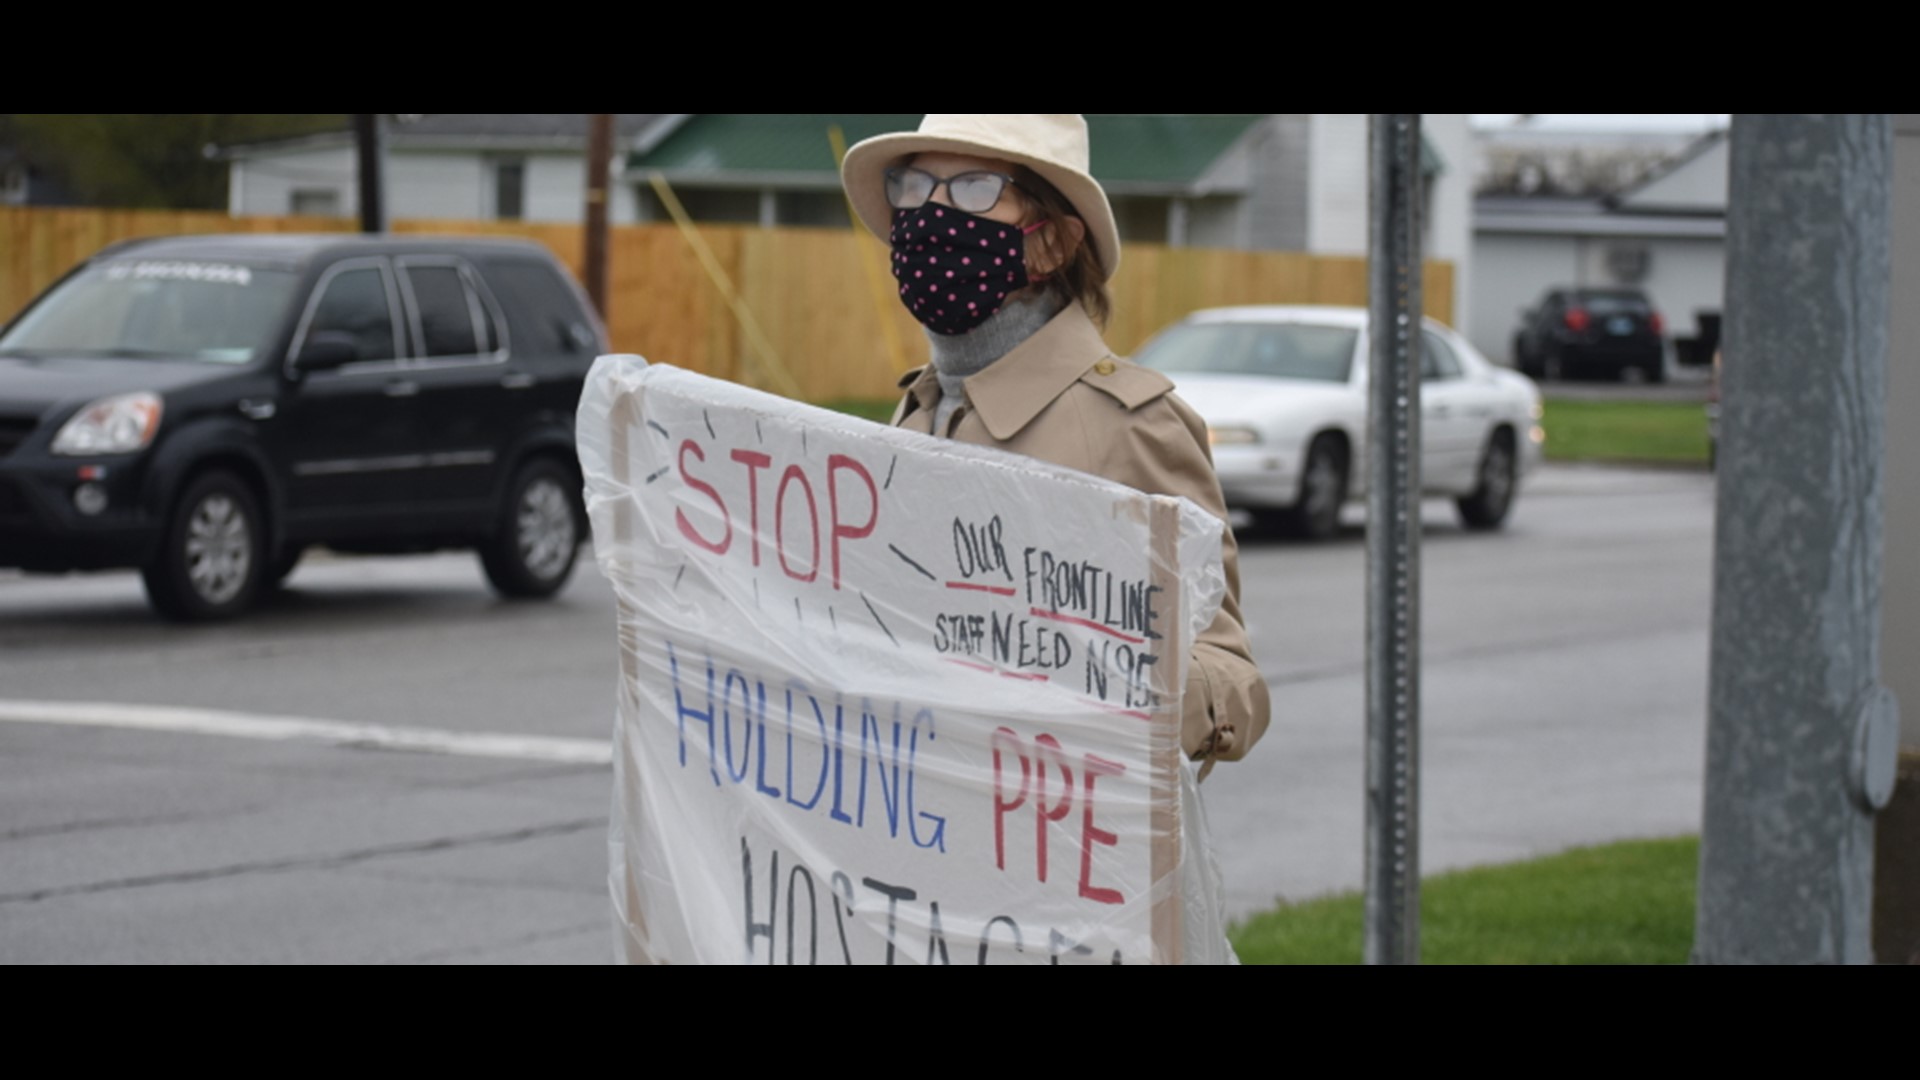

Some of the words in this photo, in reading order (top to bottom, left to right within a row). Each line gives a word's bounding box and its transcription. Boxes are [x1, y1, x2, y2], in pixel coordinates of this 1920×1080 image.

[675, 438, 879, 591] STOP
[953, 514, 1014, 582] OUR
[1023, 546, 1164, 640] FRONTLINE
[934, 612, 985, 656] STAFF
[991, 610, 1072, 670] NEED
[665, 637, 946, 854] HOLDING
[991, 726, 1127, 905] PPE
